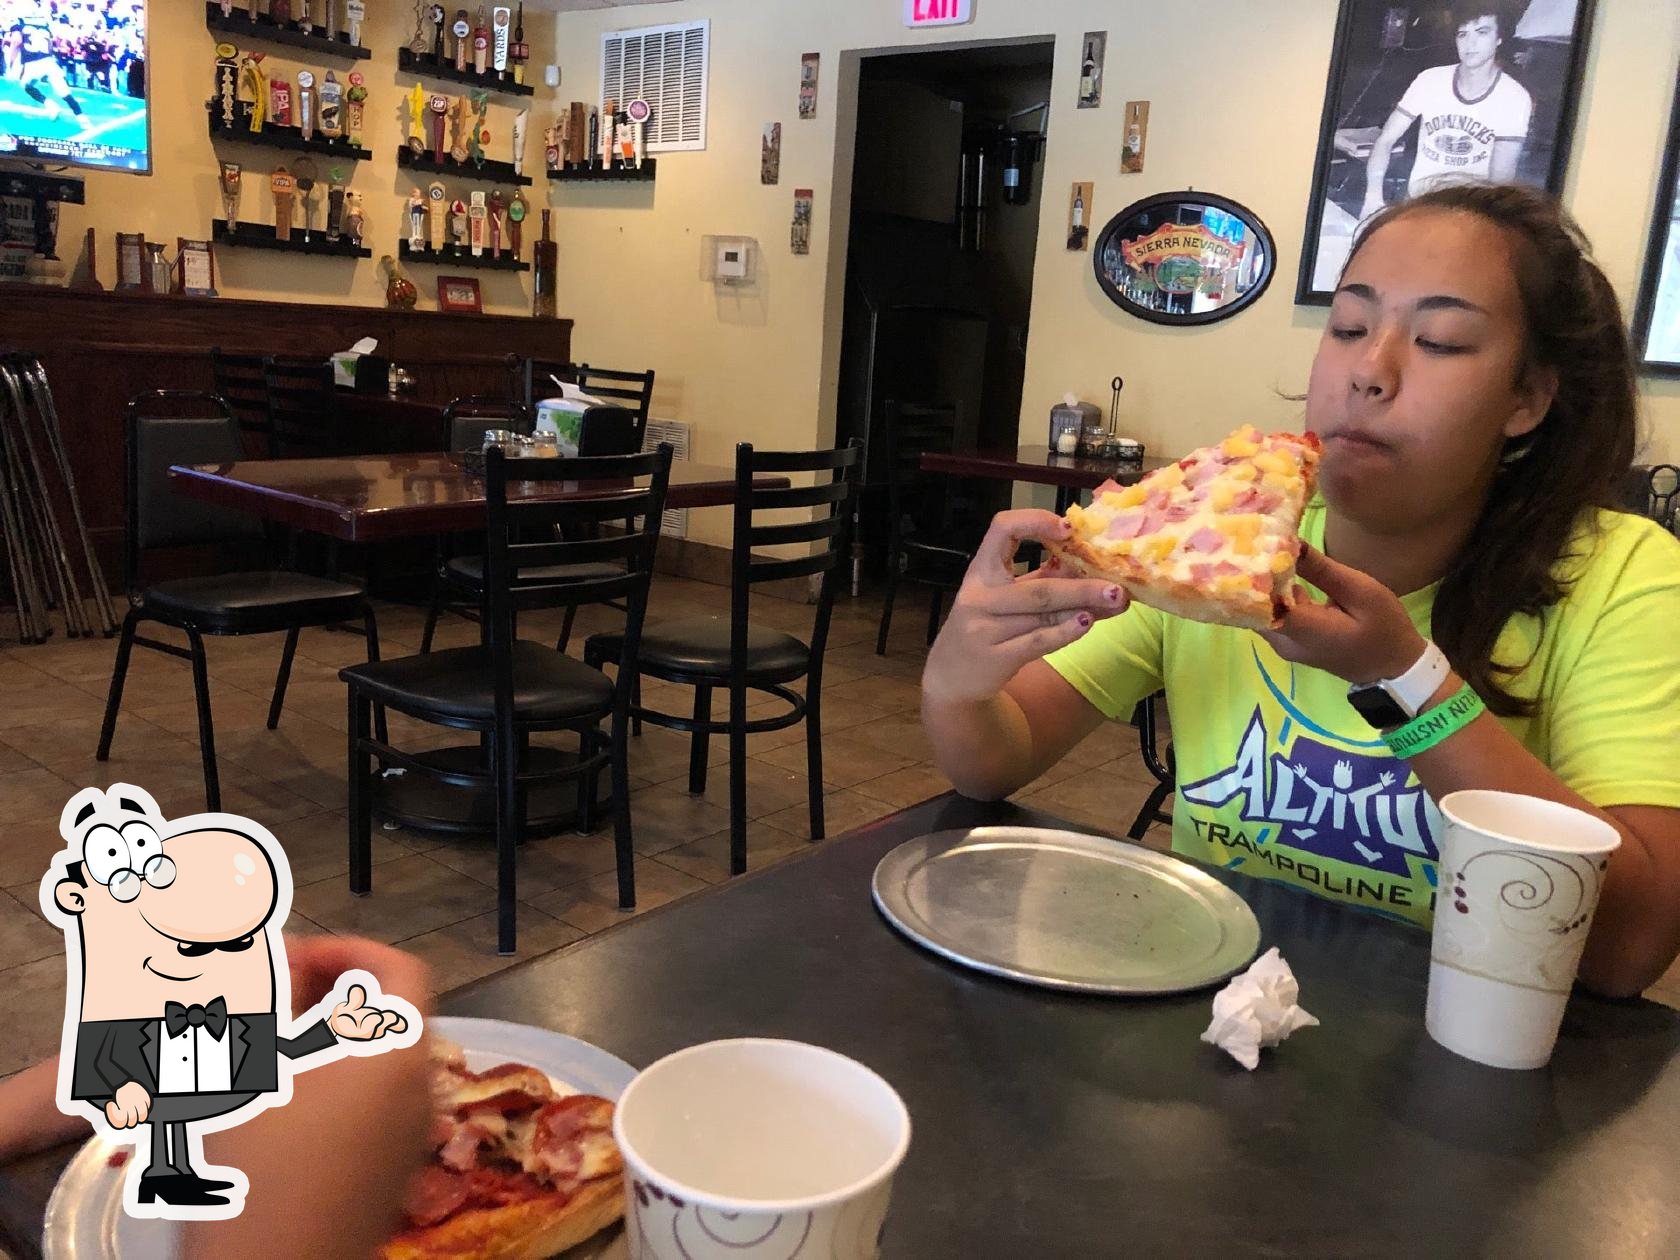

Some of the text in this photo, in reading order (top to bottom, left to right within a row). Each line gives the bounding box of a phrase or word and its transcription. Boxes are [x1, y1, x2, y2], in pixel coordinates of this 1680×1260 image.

[495, 28, 506, 64] YARDS
[1135, 236, 1230, 258] SIERRA NEVADA
[1190, 816, 1413, 906] TRAMPOLINE
